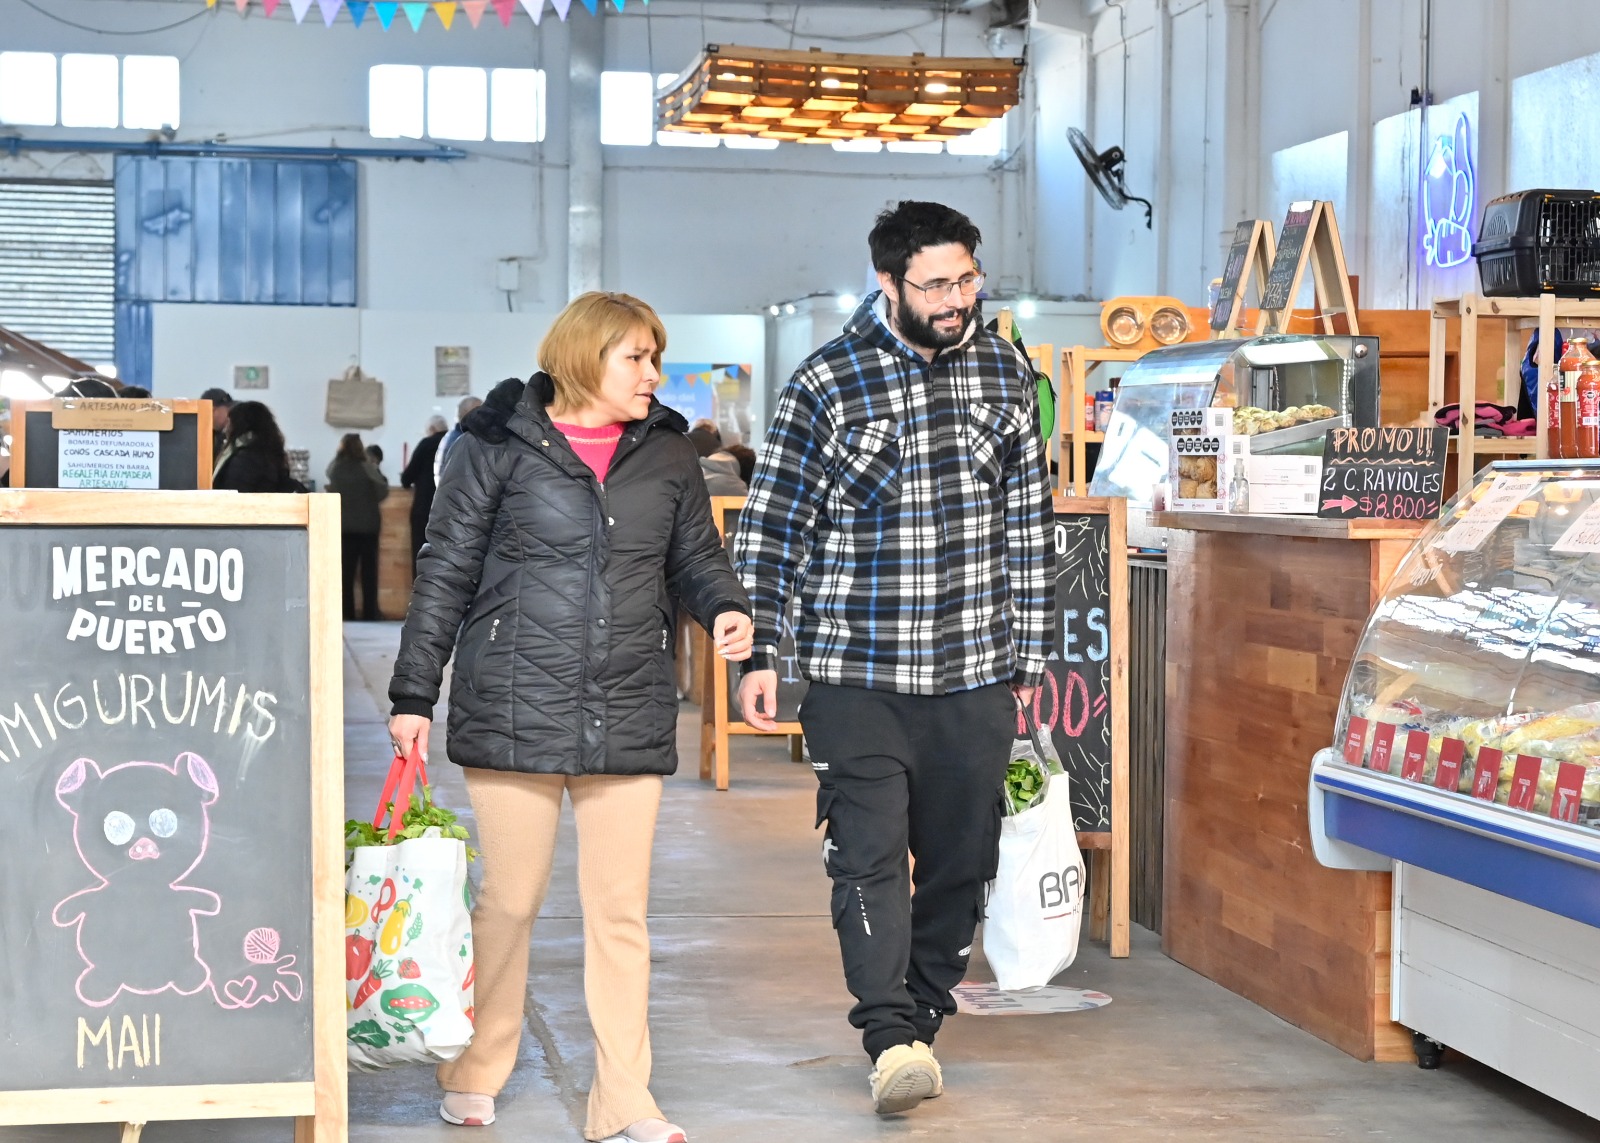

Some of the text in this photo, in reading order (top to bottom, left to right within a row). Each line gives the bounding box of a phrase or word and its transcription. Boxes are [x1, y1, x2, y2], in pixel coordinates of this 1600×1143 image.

[80, 401, 137, 411] ARTESANO
[100, 440, 154, 448] DEFUMADORAS
[64, 448, 154, 459] CONOS CASCADA HUMO
[110, 470, 120, 478] EN
[121, 470, 152, 479] MADERA
[1323, 467, 1337, 491] 2
[79, 479, 129, 488] ARTESANAL
[52, 545, 244, 602] MERCADO
[128, 595, 166, 612] DEL
[66, 607, 227, 655] PUERTO
[0, 671, 278, 763] MIGURUMIS
[950, 987, 1024, 1010] CAJA
